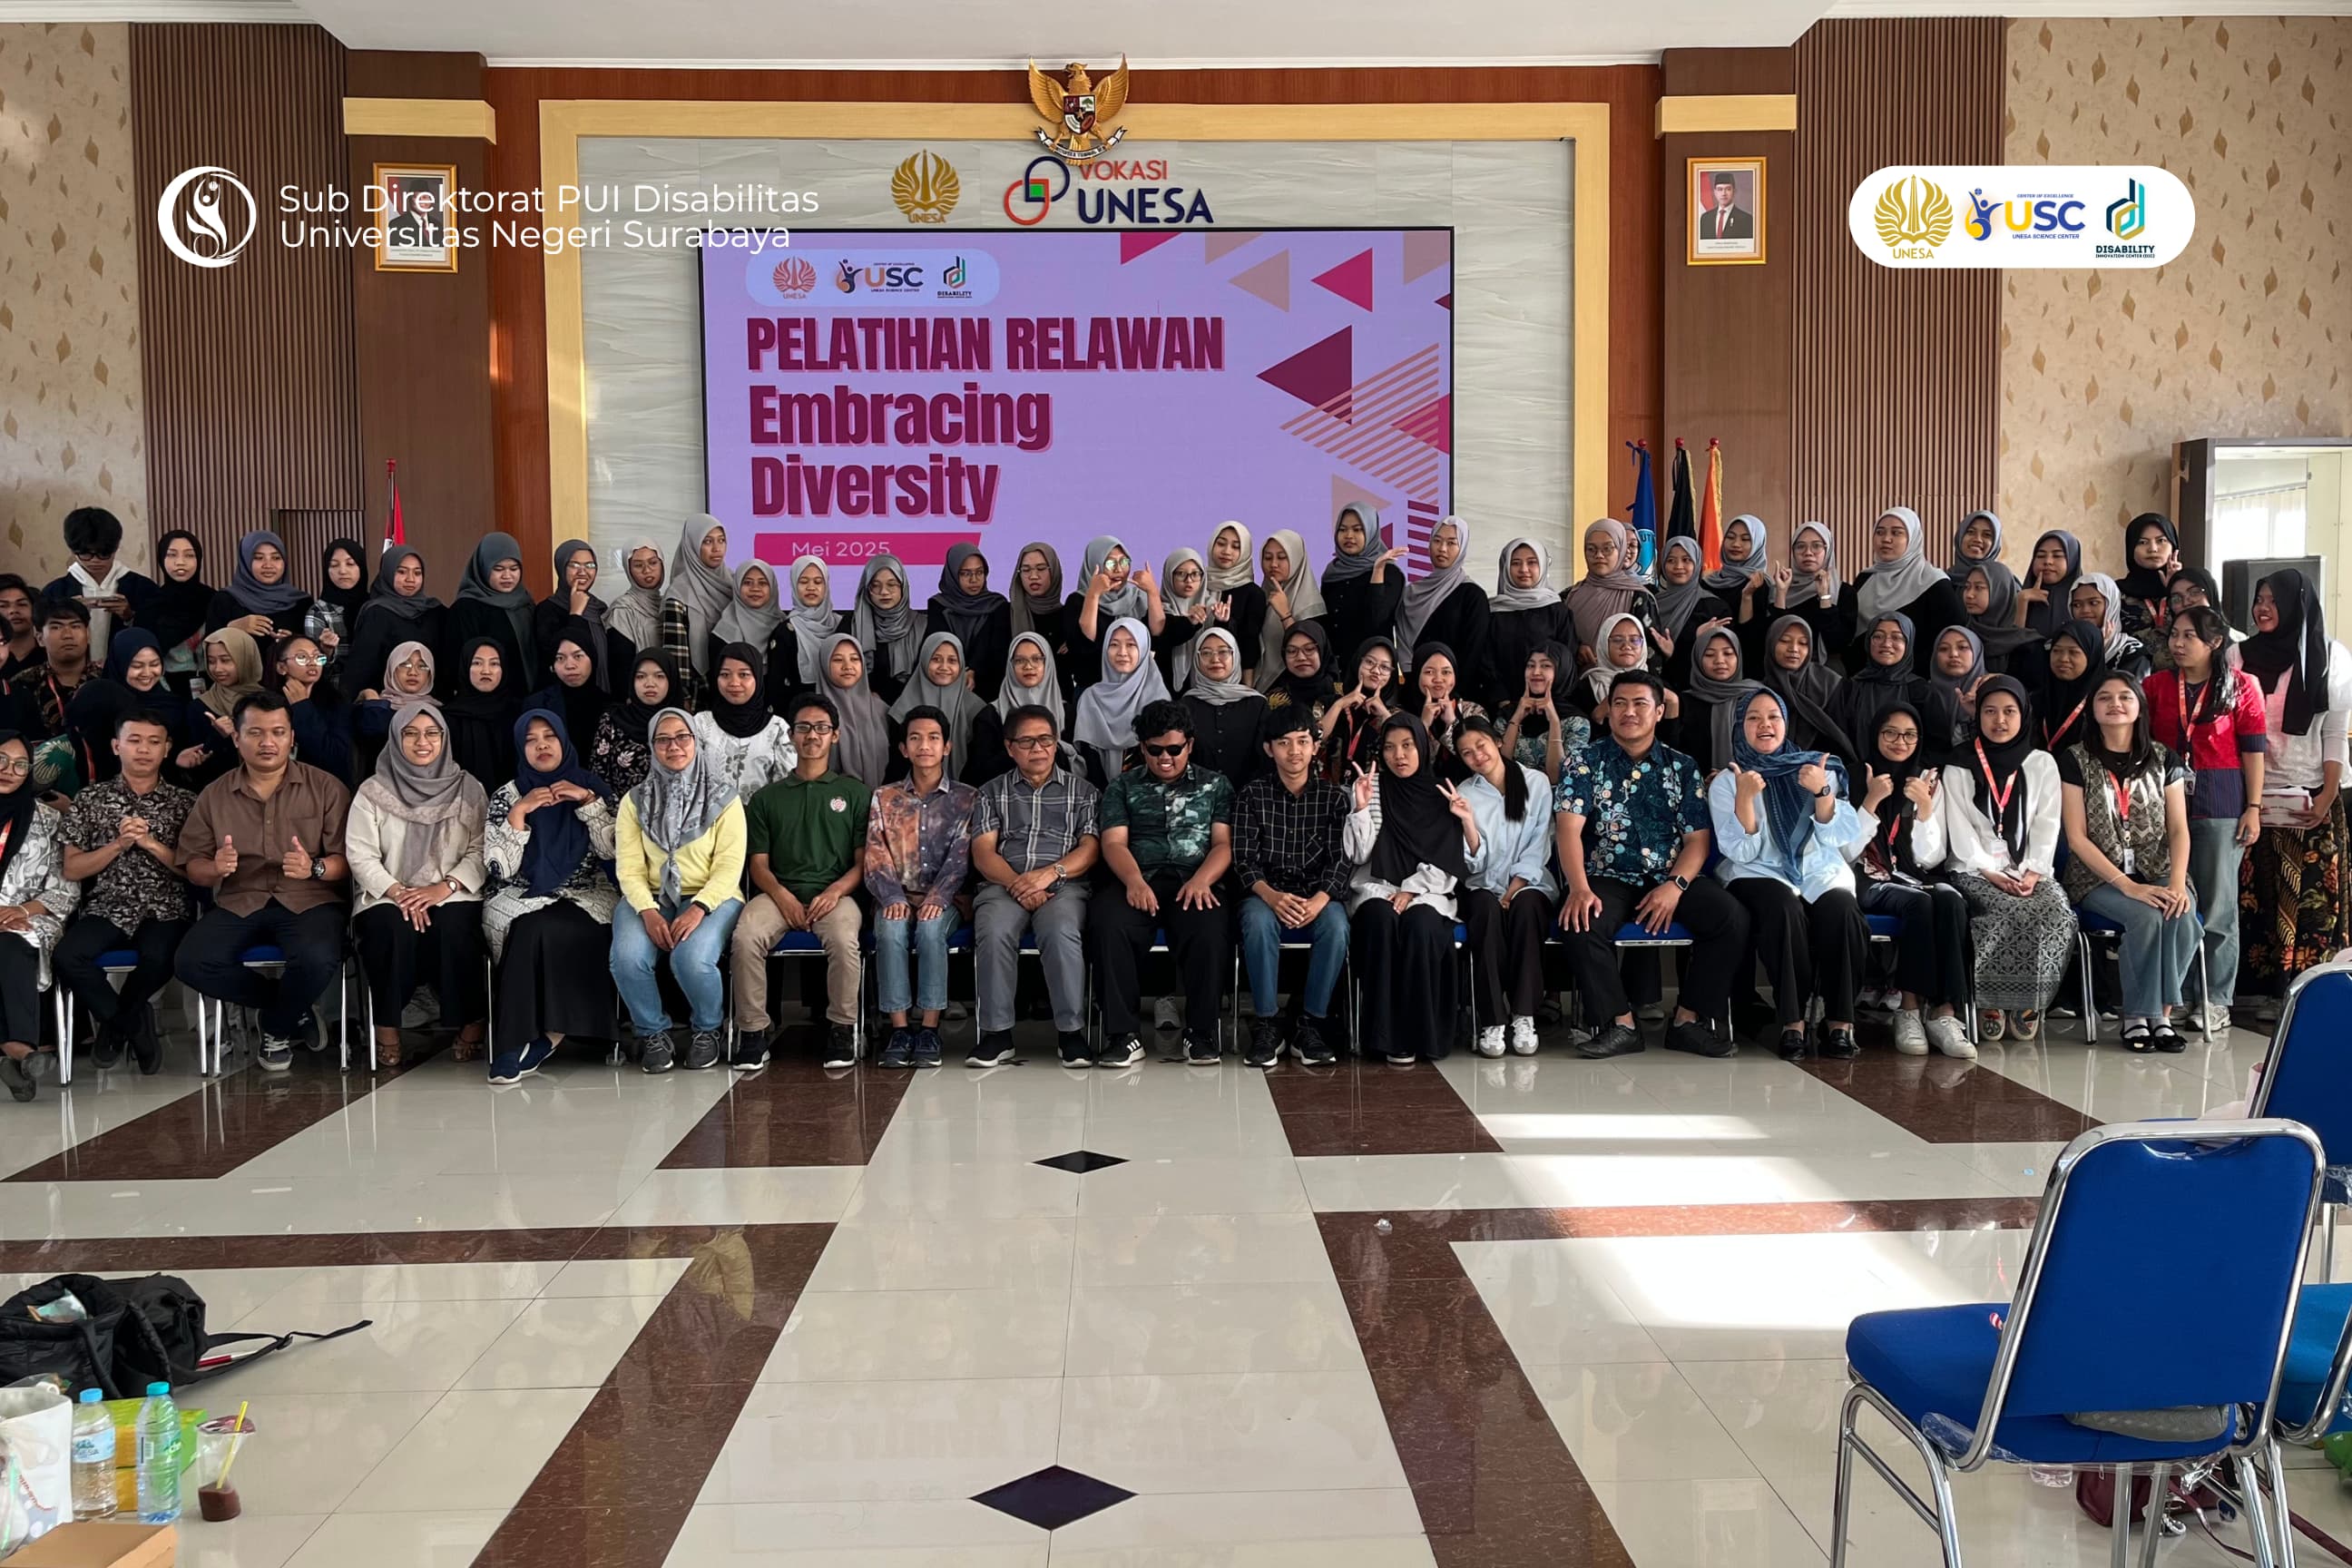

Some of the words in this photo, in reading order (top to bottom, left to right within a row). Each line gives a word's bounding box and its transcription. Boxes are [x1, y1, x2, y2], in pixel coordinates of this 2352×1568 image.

[1079, 160, 1168, 181] VOKASI
[908, 212, 946, 224] UNESA
[1078, 188, 1214, 224] UNESA
[865, 267, 924, 288] USC
[747, 318, 993, 372] PELATIHAN
[1006, 317, 1225, 371] RELAWAN
[750, 381, 1054, 451] Embracing
[751, 453, 1001, 523] Diversity
[792, 541, 830, 557] Mei
[836, 542, 891, 557] 2025
